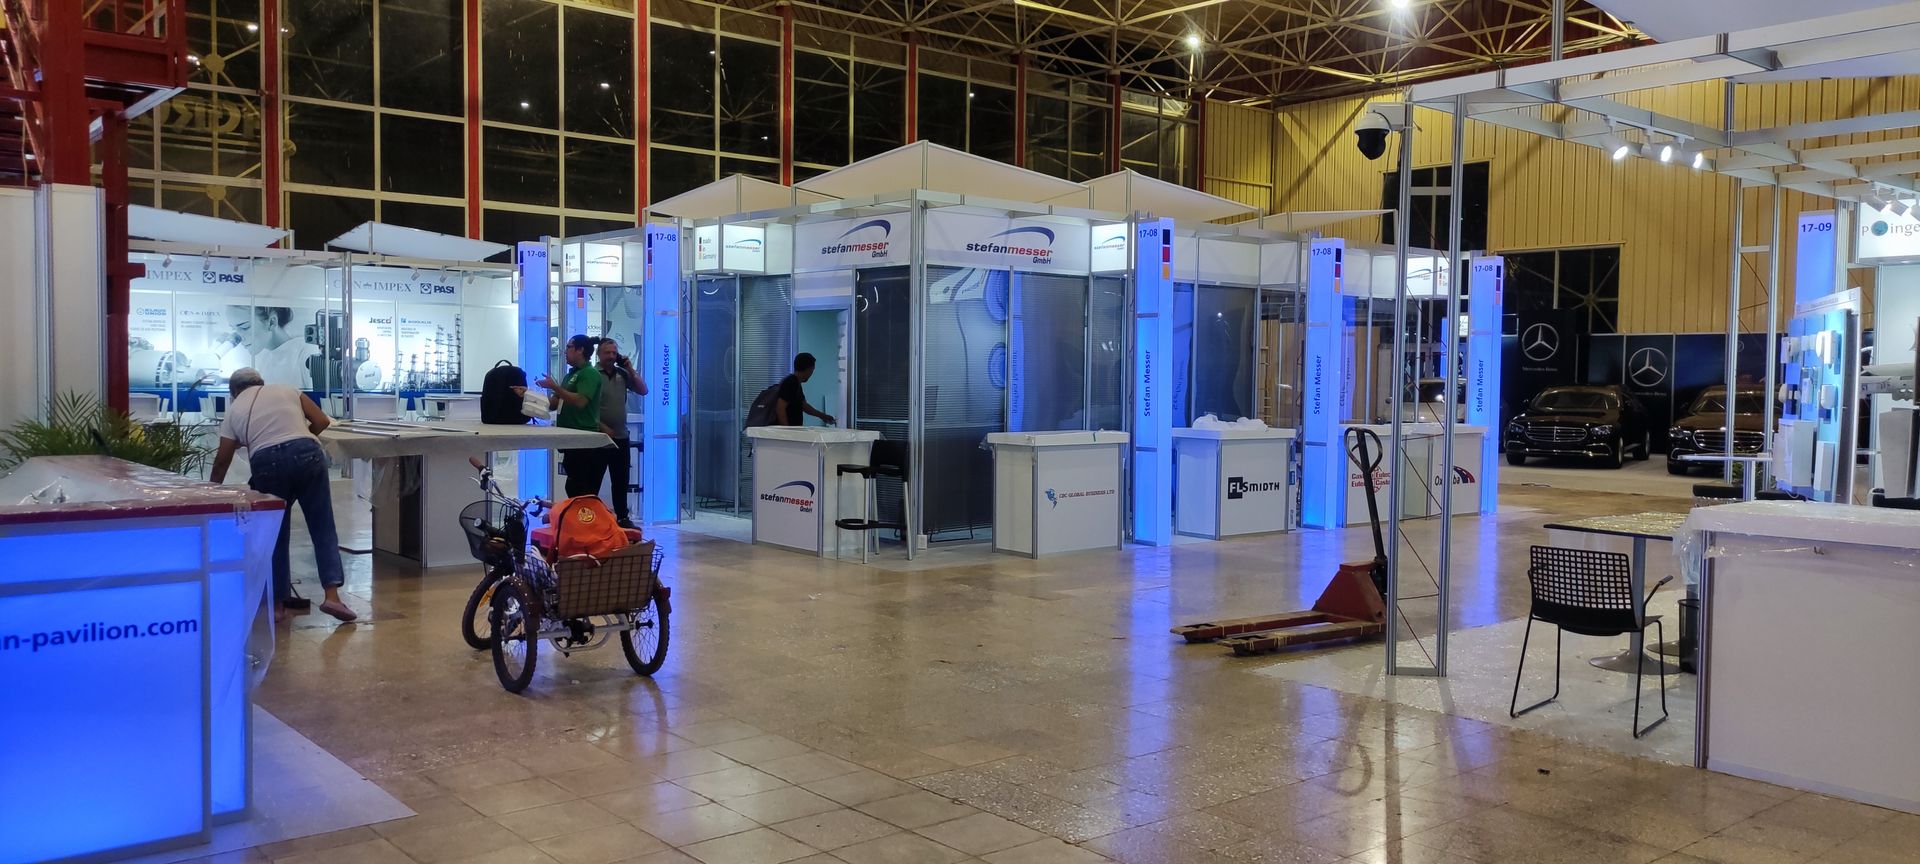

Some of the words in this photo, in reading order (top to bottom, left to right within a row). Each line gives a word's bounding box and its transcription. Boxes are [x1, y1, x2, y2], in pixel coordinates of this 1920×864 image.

[1138, 228, 1158, 239] 17-08
[1801, 222, 1832, 233] 17-09
[655, 233, 677, 242] 17-08
[527, 250, 547, 258] 17-08
[821, 241, 889, 255] stefanmesser
[871, 250, 888, 259] GmbH
[966, 242, 1053, 257] stefanmesser
[1312, 247, 1332, 257] 17-08
[1032, 256, 1052, 264] GmbH
[1474, 264, 1493, 272] 17-08
[146, 270, 193, 281] IMPEX
[219, 274, 244, 283] PASI
[333, 279, 362, 290] CN
[374, 282, 412, 292] IMPEX
[433, 285, 455, 294] PASI
[662, 343, 670, 375] Messer
[1143, 349, 1151, 383] Messer
[1313, 354, 1322, 384] Messer
[1476, 359, 1484, 386] Messer
[662, 376, 670, 406] Stefan
[1143, 385, 1151, 416] Stefan
[1313, 386, 1322, 415] Stefan
[1476, 387, 1484, 412] Stefan
[760, 492, 814, 508] stefanmesser
[0, 618, 198, 652] n-pavilion.com
